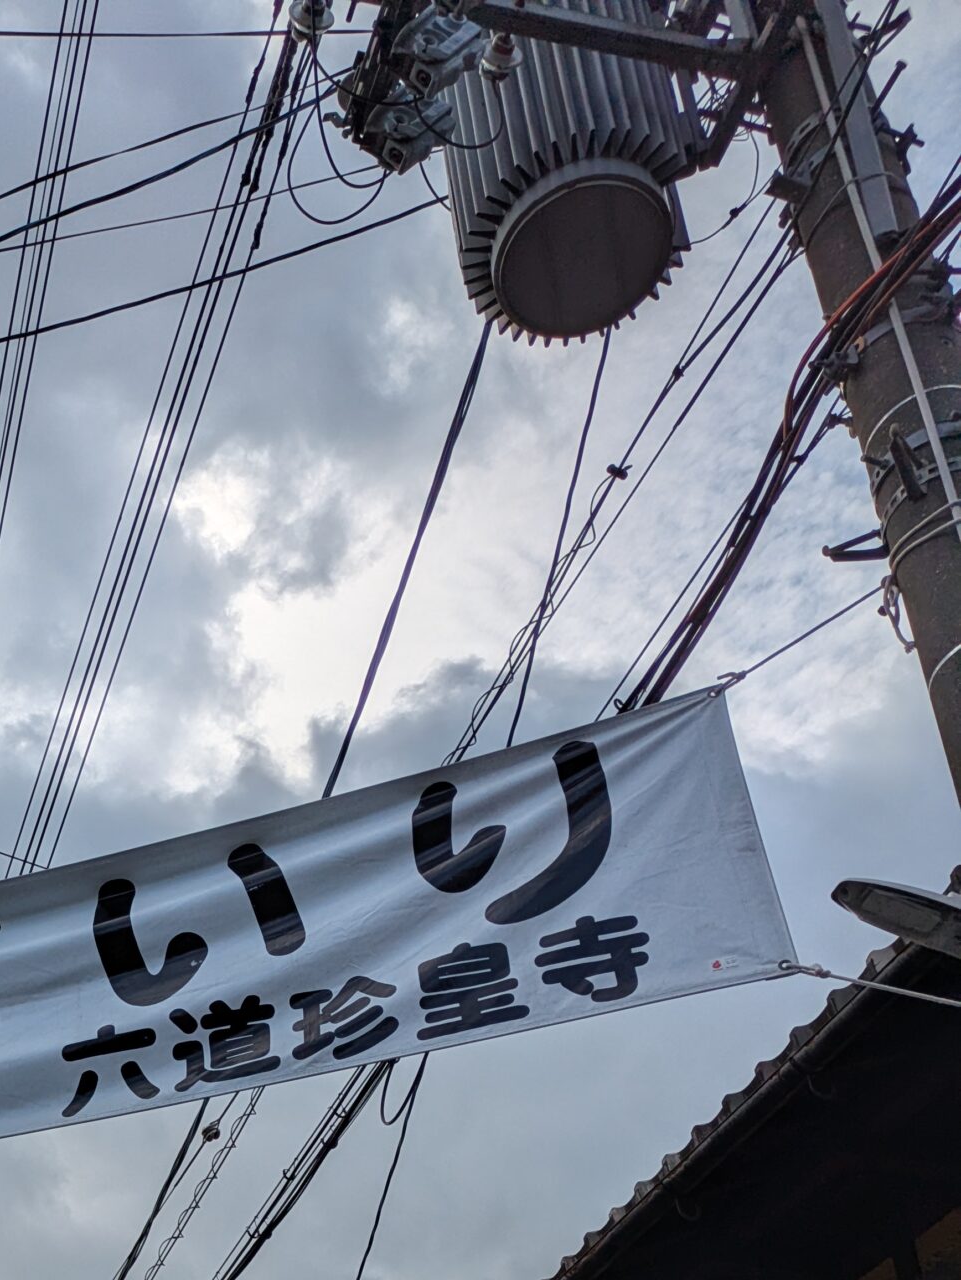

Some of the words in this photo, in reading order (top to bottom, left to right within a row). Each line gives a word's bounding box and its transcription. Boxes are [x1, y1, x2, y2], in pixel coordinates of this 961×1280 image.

[61, 916, 649, 1117] 六道珍皇寺
